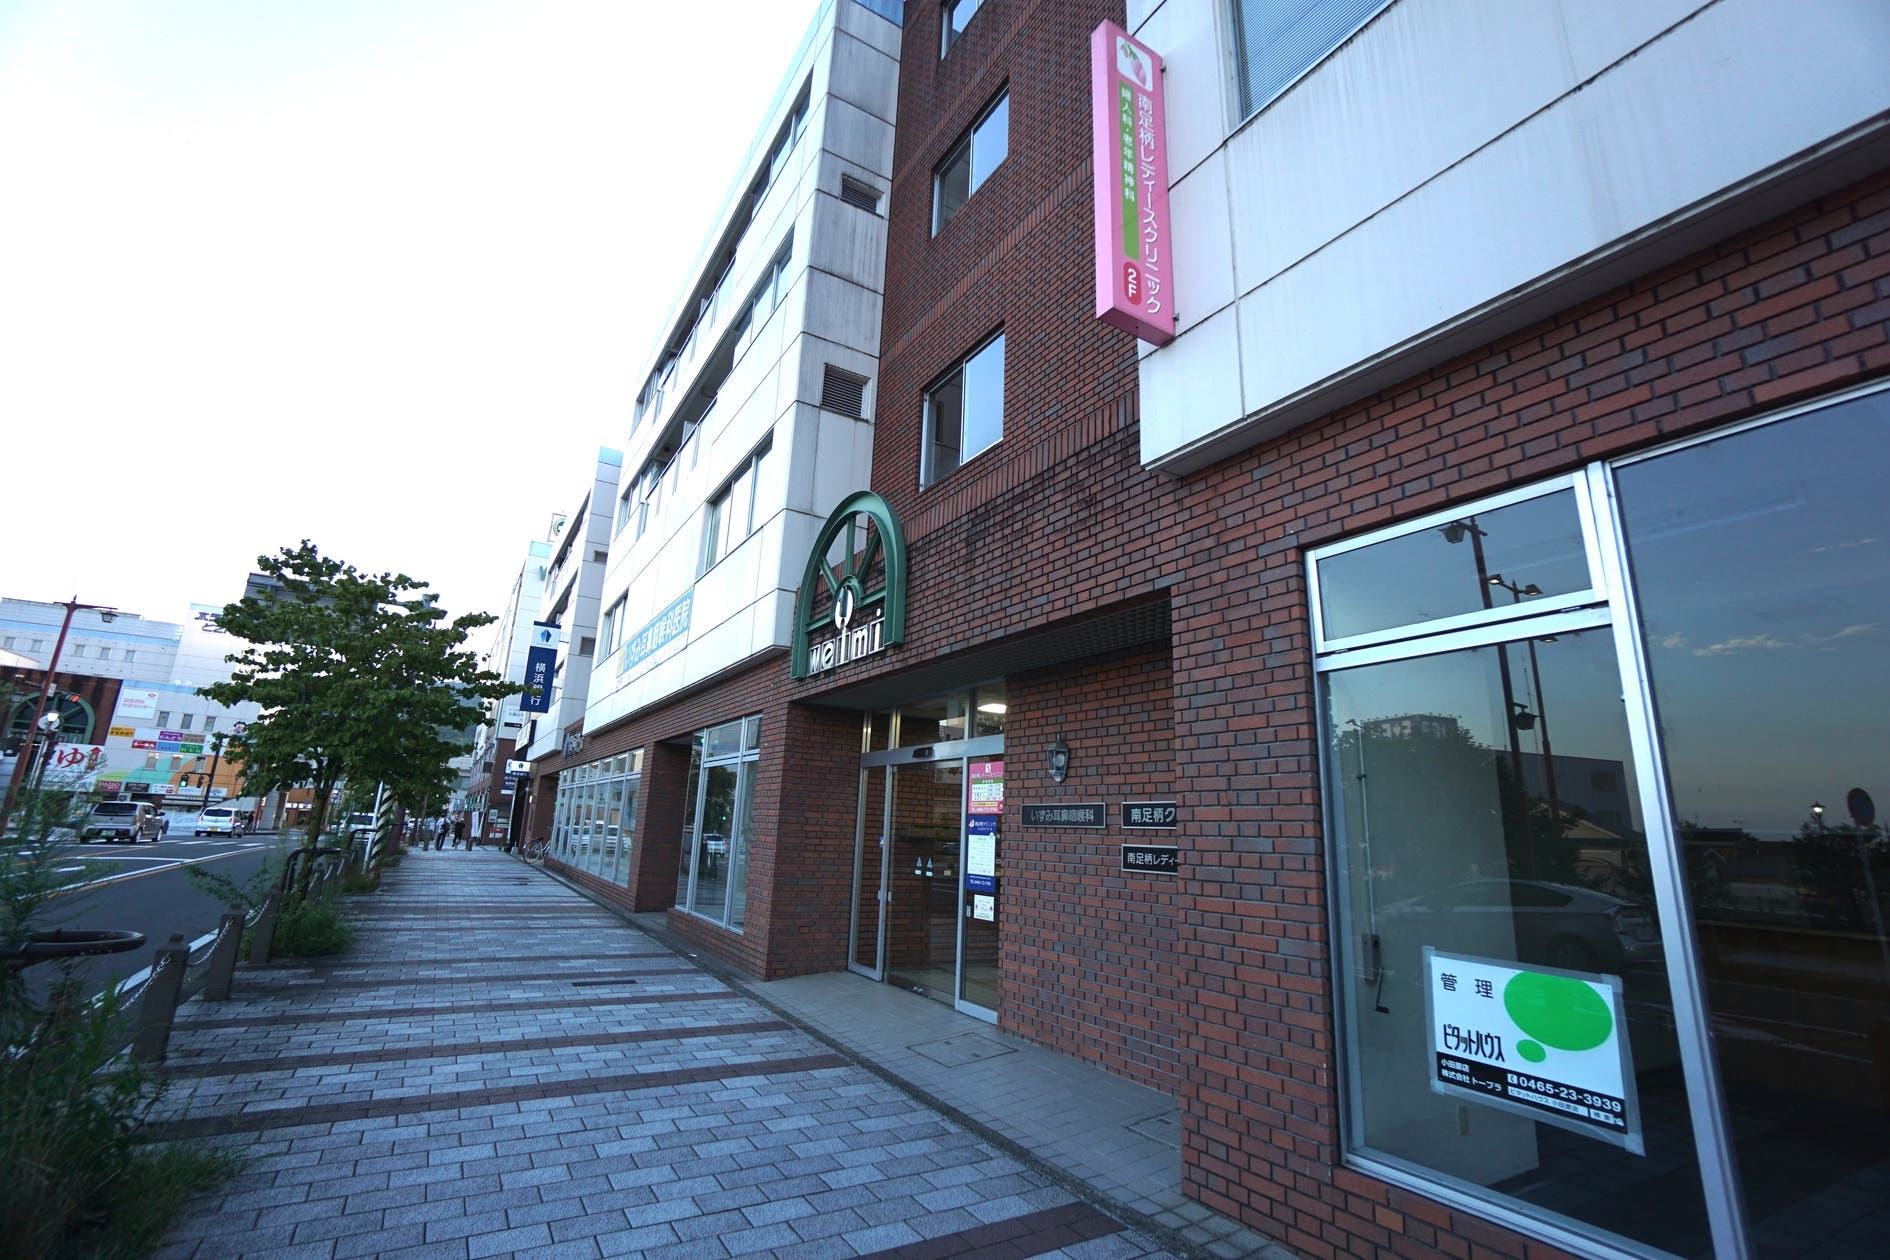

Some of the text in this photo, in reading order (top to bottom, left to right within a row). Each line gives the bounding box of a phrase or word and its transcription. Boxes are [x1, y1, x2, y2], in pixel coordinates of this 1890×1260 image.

[1137, 92, 1162, 314] 南足柄レディースクリニック
[1128, 268, 1137, 298] 2F
[57, 747, 86, 769] ゆ
[1131, 807, 1176, 824] 南足柄ク
[1443, 1024, 1506, 1063] ピタットハウス
[1519, 1076, 1622, 1113] 0465-23-3939
